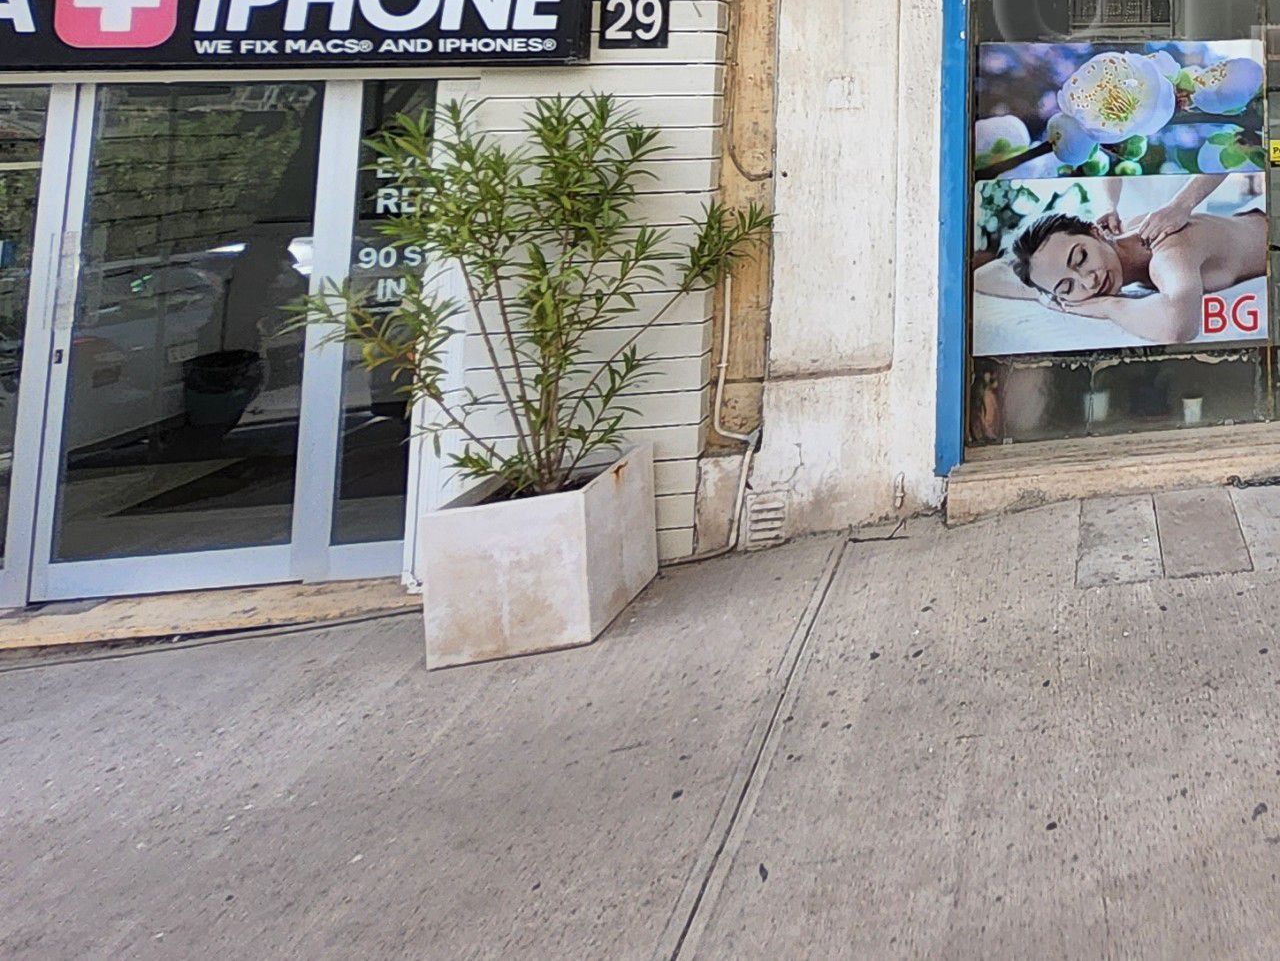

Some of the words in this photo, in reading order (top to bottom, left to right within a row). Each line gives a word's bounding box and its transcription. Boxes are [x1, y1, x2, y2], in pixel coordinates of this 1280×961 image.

[194, 40, 233, 54] WE
[240, 40, 278, 54] FIX
[379, 39, 432, 53] AND
[358, 247, 397, 269] 90
[1203, 294, 1259, 334] BG
